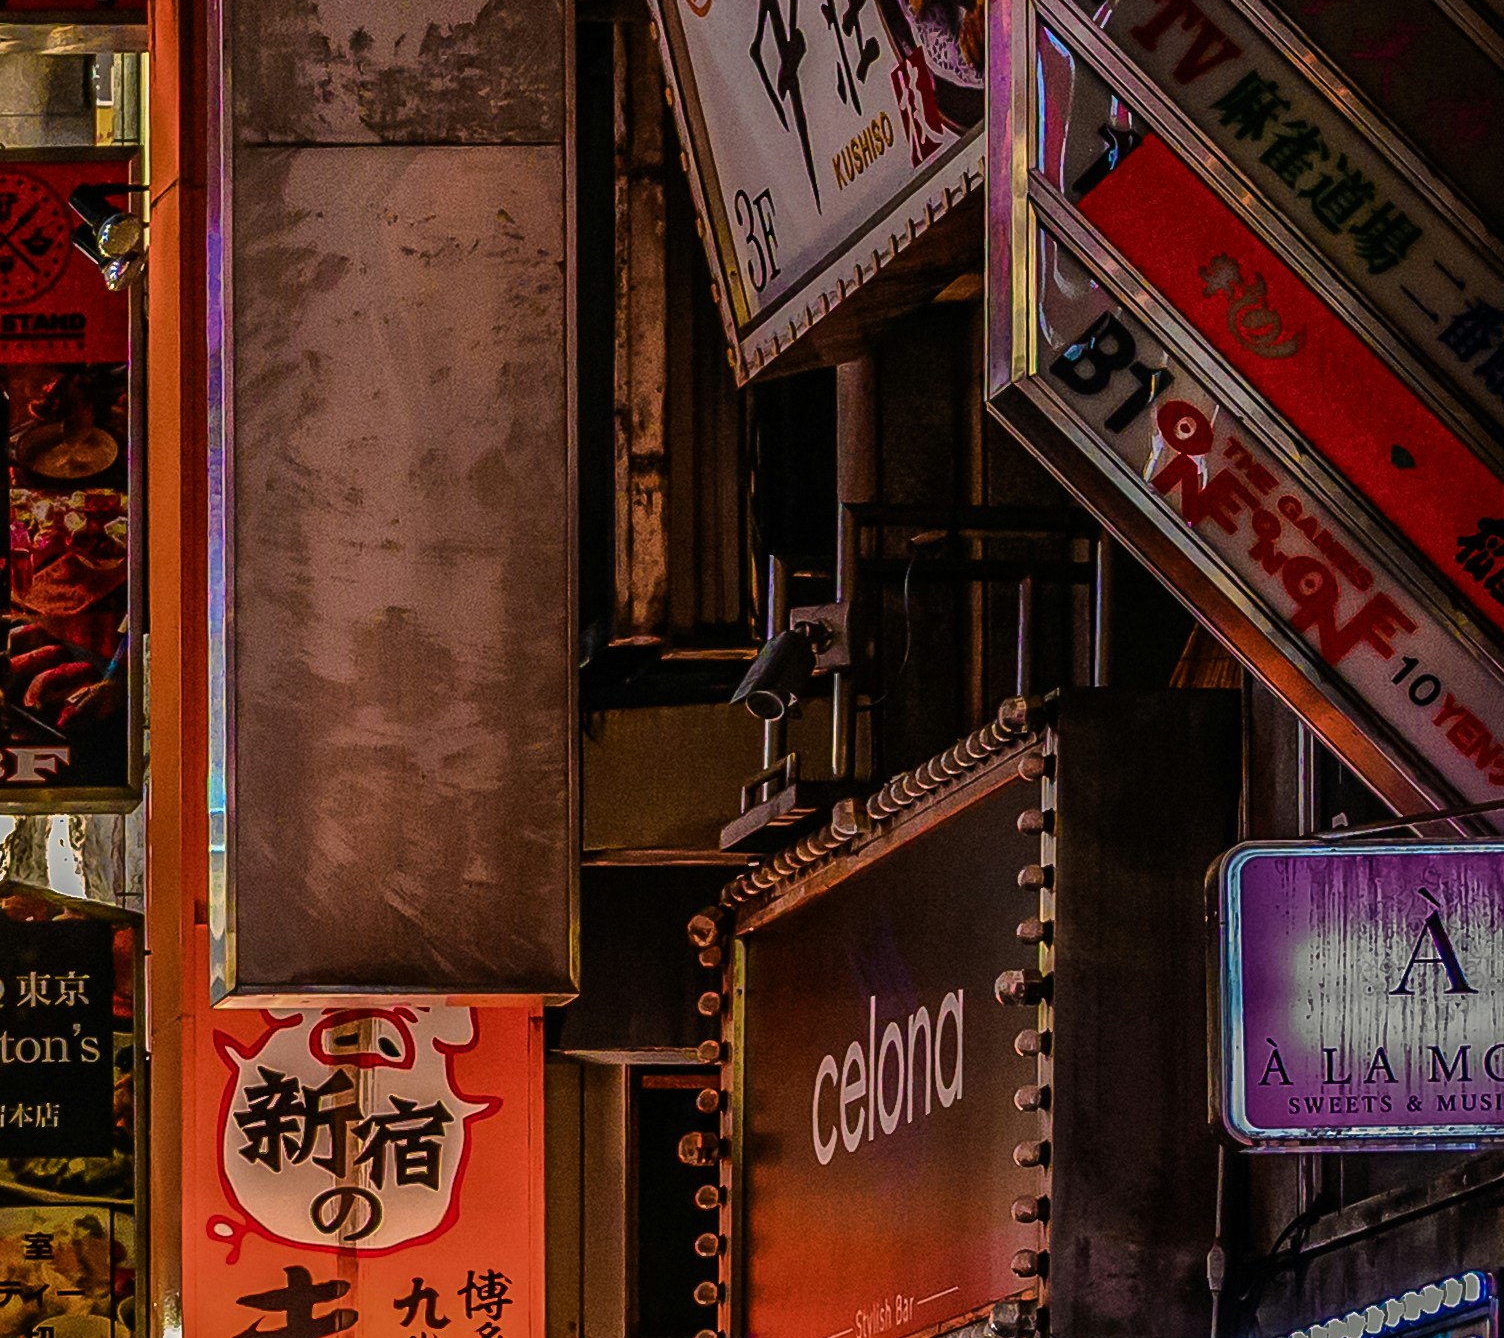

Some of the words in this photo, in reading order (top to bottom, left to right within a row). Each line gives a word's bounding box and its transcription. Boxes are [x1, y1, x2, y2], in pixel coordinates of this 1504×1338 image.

[1, 314, 87, 333] STAND
[16, 971, 91, 1008] 東京
[809, 986, 969, 1163] celona
